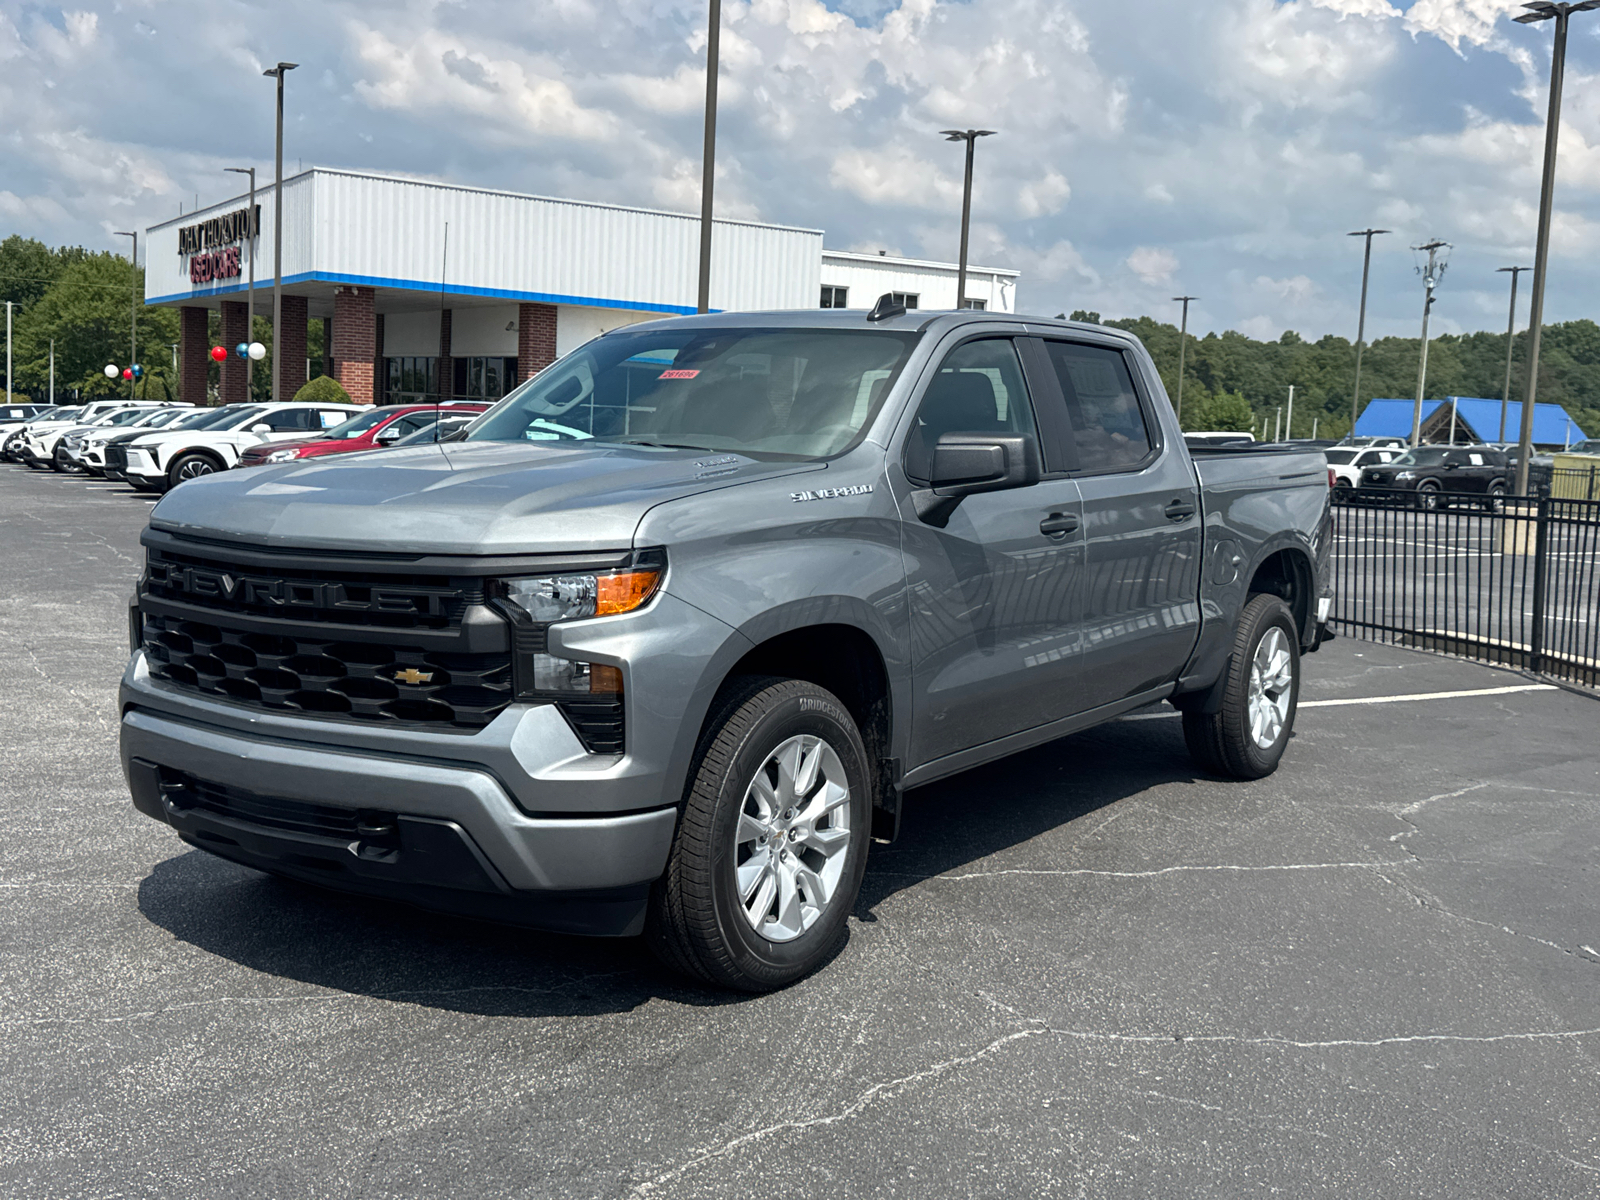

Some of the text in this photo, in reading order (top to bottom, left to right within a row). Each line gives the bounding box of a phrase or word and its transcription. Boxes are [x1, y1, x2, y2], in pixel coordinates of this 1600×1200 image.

[178, 224, 203, 255] JOHN
[190, 246, 241, 284] USED CARS
[789, 484, 874, 503] SILVERADO
[147, 560, 465, 617] CHEVROLET
[800, 697, 853, 734] BRIDGESTONE
